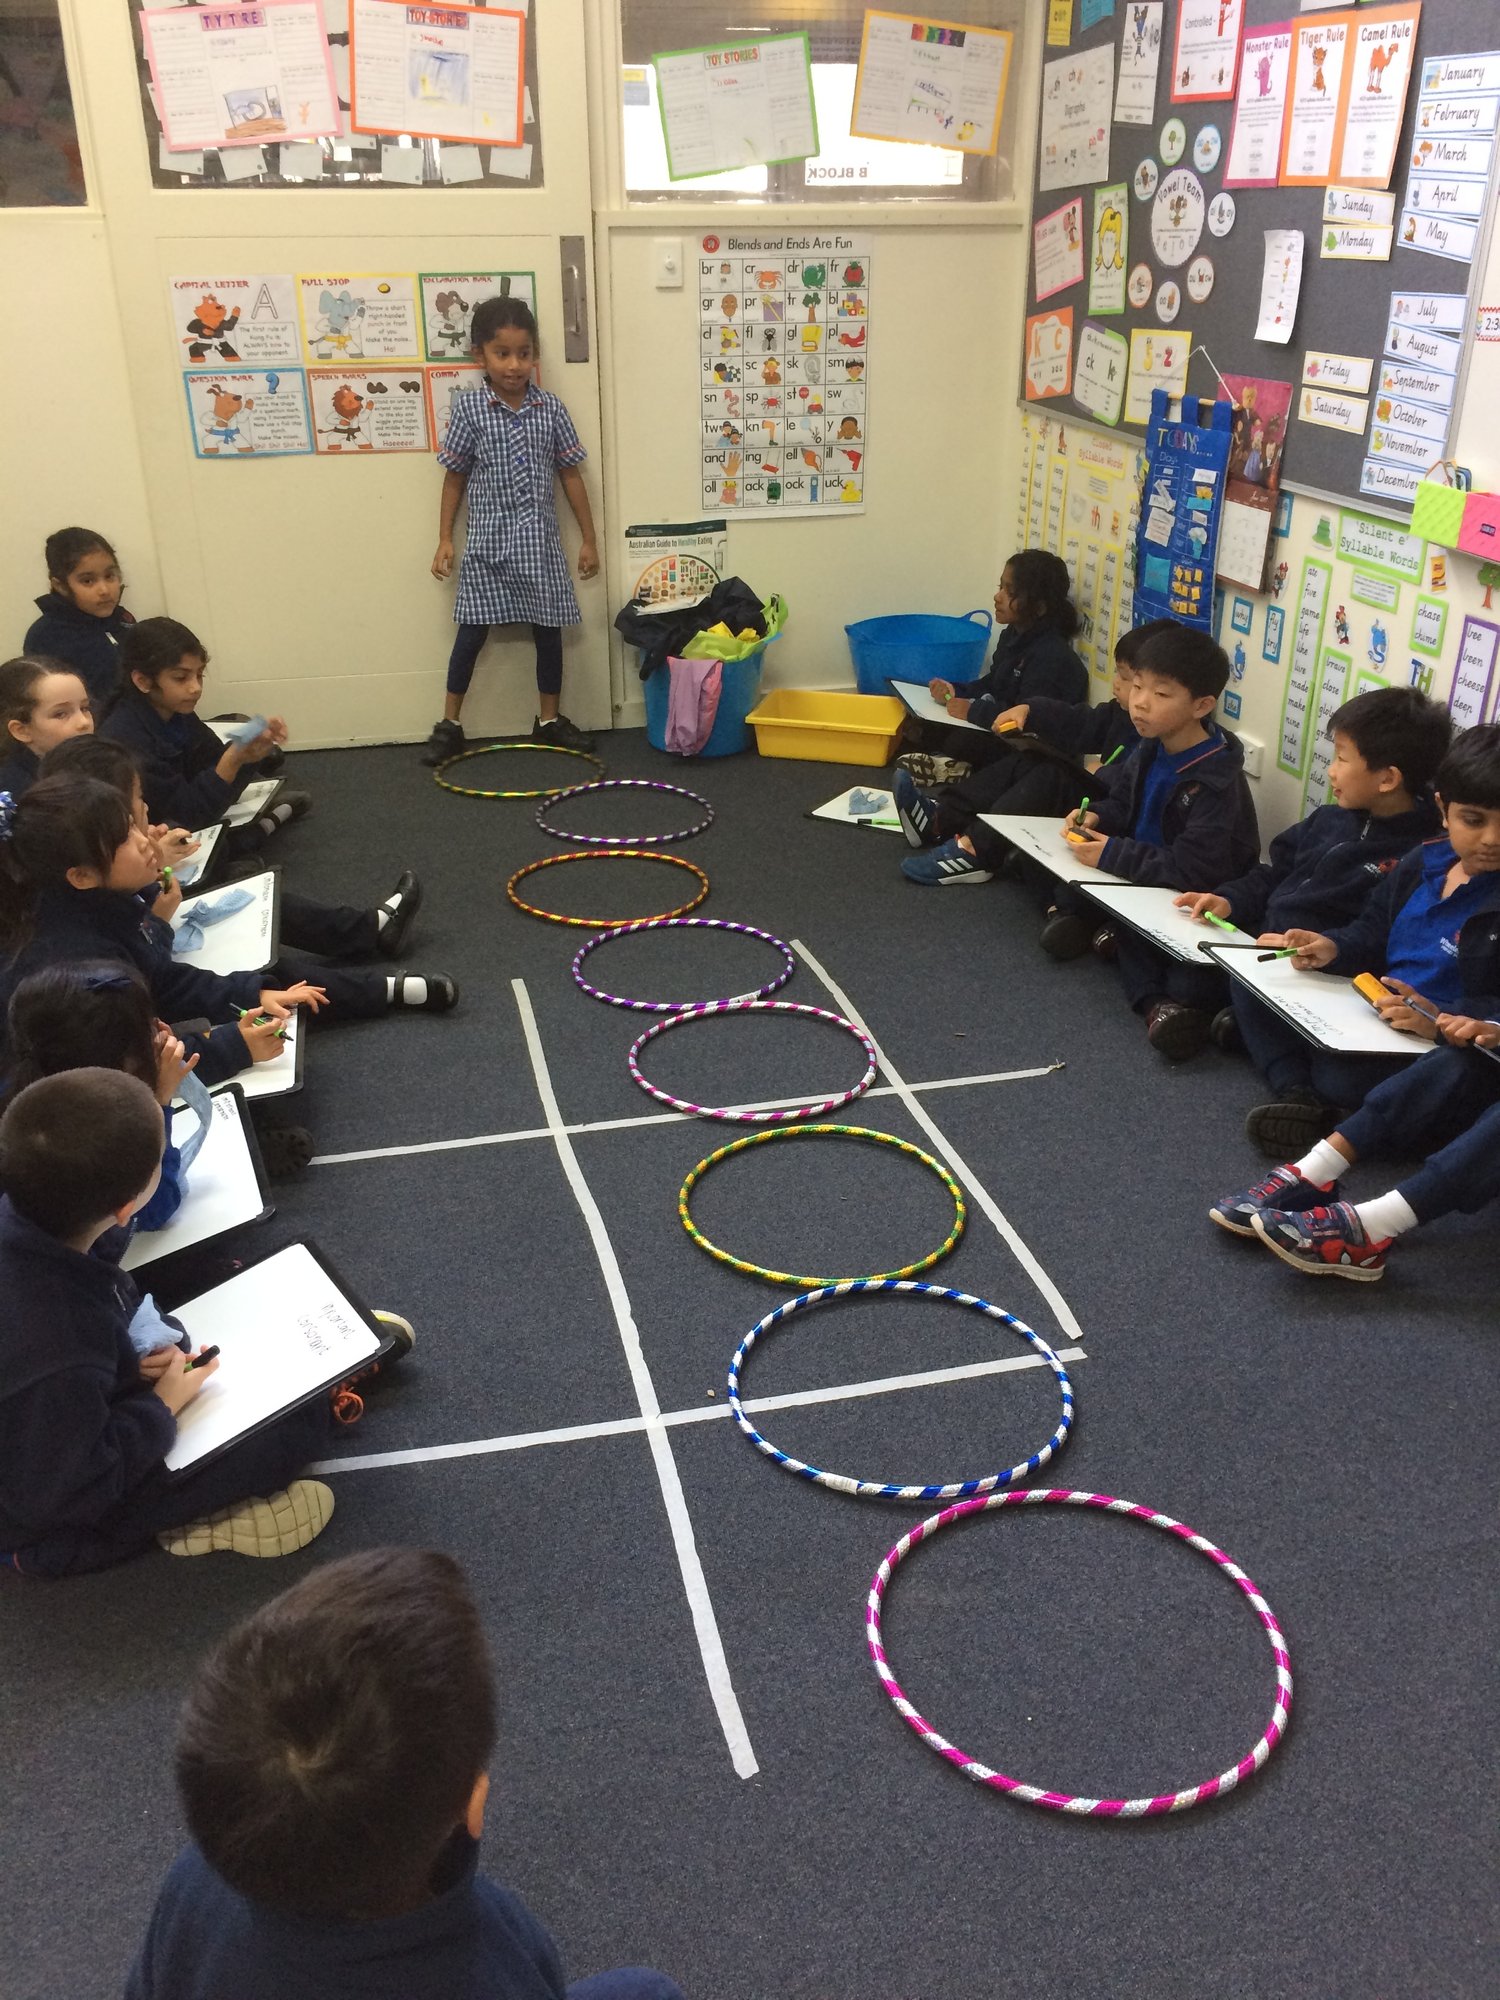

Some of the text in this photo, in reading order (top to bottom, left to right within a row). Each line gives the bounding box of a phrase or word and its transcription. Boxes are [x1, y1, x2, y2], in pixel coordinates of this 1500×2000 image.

[409, 9, 426, 23] TOY
[1301, 27, 1345, 48] Tiger Rule
[1361, 23, 1410, 42] Camel Rule
[1246, 41, 1272, 53] Monster
[1273, 36, 1289, 49] Rule
[706, 53, 722, 66] TOY
[1441, 64, 1486, 86] January
[1433, 104, 1480, 127] February
[1434, 143, 1467, 161] March
[1158, 176, 1203, 204] Vowel Team
[1432, 186, 1460, 208] April
[1342, 194, 1374, 214] Sunday
[1426, 221, 1449, 249] May
[728, 236, 852, 250] Blends and Ends Are Fun
[1339, 231, 1375, 254] Monday
[702, 261, 714, 274] br
[745, 263, 755, 274] cr
[788, 260, 799, 273] dr
[830, 260, 839, 272] fr
[215, 279, 250, 289] LETTER
[301, 278, 350, 286] FULL STOP
[251, 282, 278, 320] A
[702, 298, 714, 311] gr
[745, 297, 757, 310] pr
[788, 293, 796, 304] tr
[829, 292, 839, 304] bl
[1417, 299, 1438, 324] July
[703, 327, 712, 339] cl
[745, 326, 752, 338] fl
[787, 325, 797, 341] gl
[828, 324, 838, 339] pl
[1406, 337, 1438, 360] August
[703, 357, 711, 371] sl
[745, 360, 757, 370] sc
[787, 356, 799, 368] sk
[828, 357, 845, 367] sm
[430, 371, 459, 379] COMMA
[1322, 359, 1351, 384] Friday
[1393, 370, 1440, 393] September
[704, 393, 717, 403] sn
[746, 393, 759, 406] sp
[786, 387, 797, 399] st
[827, 389, 842, 398] sw
[1314, 397, 1351, 424] Saturday
[1393, 404, 1428, 428] October
[704, 421, 718, 433] tw
[745, 419, 759, 432] kn
[786, 418, 796, 430] le
[826, 420, 834, 432] y
[1383, 432, 1429, 458] November
[704, 451, 726, 463] and
[745, 450, 762, 464] ing
[786, 448, 798, 460] ell
[745, 479, 764, 491] ack
[785, 477, 804, 489] ock
[825, 475, 844, 488] uck
[1376, 467, 1419, 491] December
[704, 480, 717, 493] oll
[629, 538, 655, 549] Australian
[657, 538, 671, 548] Guide
[671, 539, 678, 547] to
[698, 536, 713, 545] Eating
[1340, 536, 1418, 571] Syllable Words
[1300, 607, 1320, 620] game
[1418, 604, 1441, 622] chase
[1414, 627, 1437, 646] chime
[1467, 623, 1482, 642] bee
[1462, 648, 1483, 668] been
[1291, 678, 1309, 693] made
[1322, 677, 1340, 695] close
[1457, 672, 1485, 693] cheese
[1288, 697, 1306, 712] make
[1453, 696, 1473, 718] deep
[1283, 733, 1297, 746] ride
[1282, 750, 1296, 765] take
[1310, 772, 1325, 787] slide
